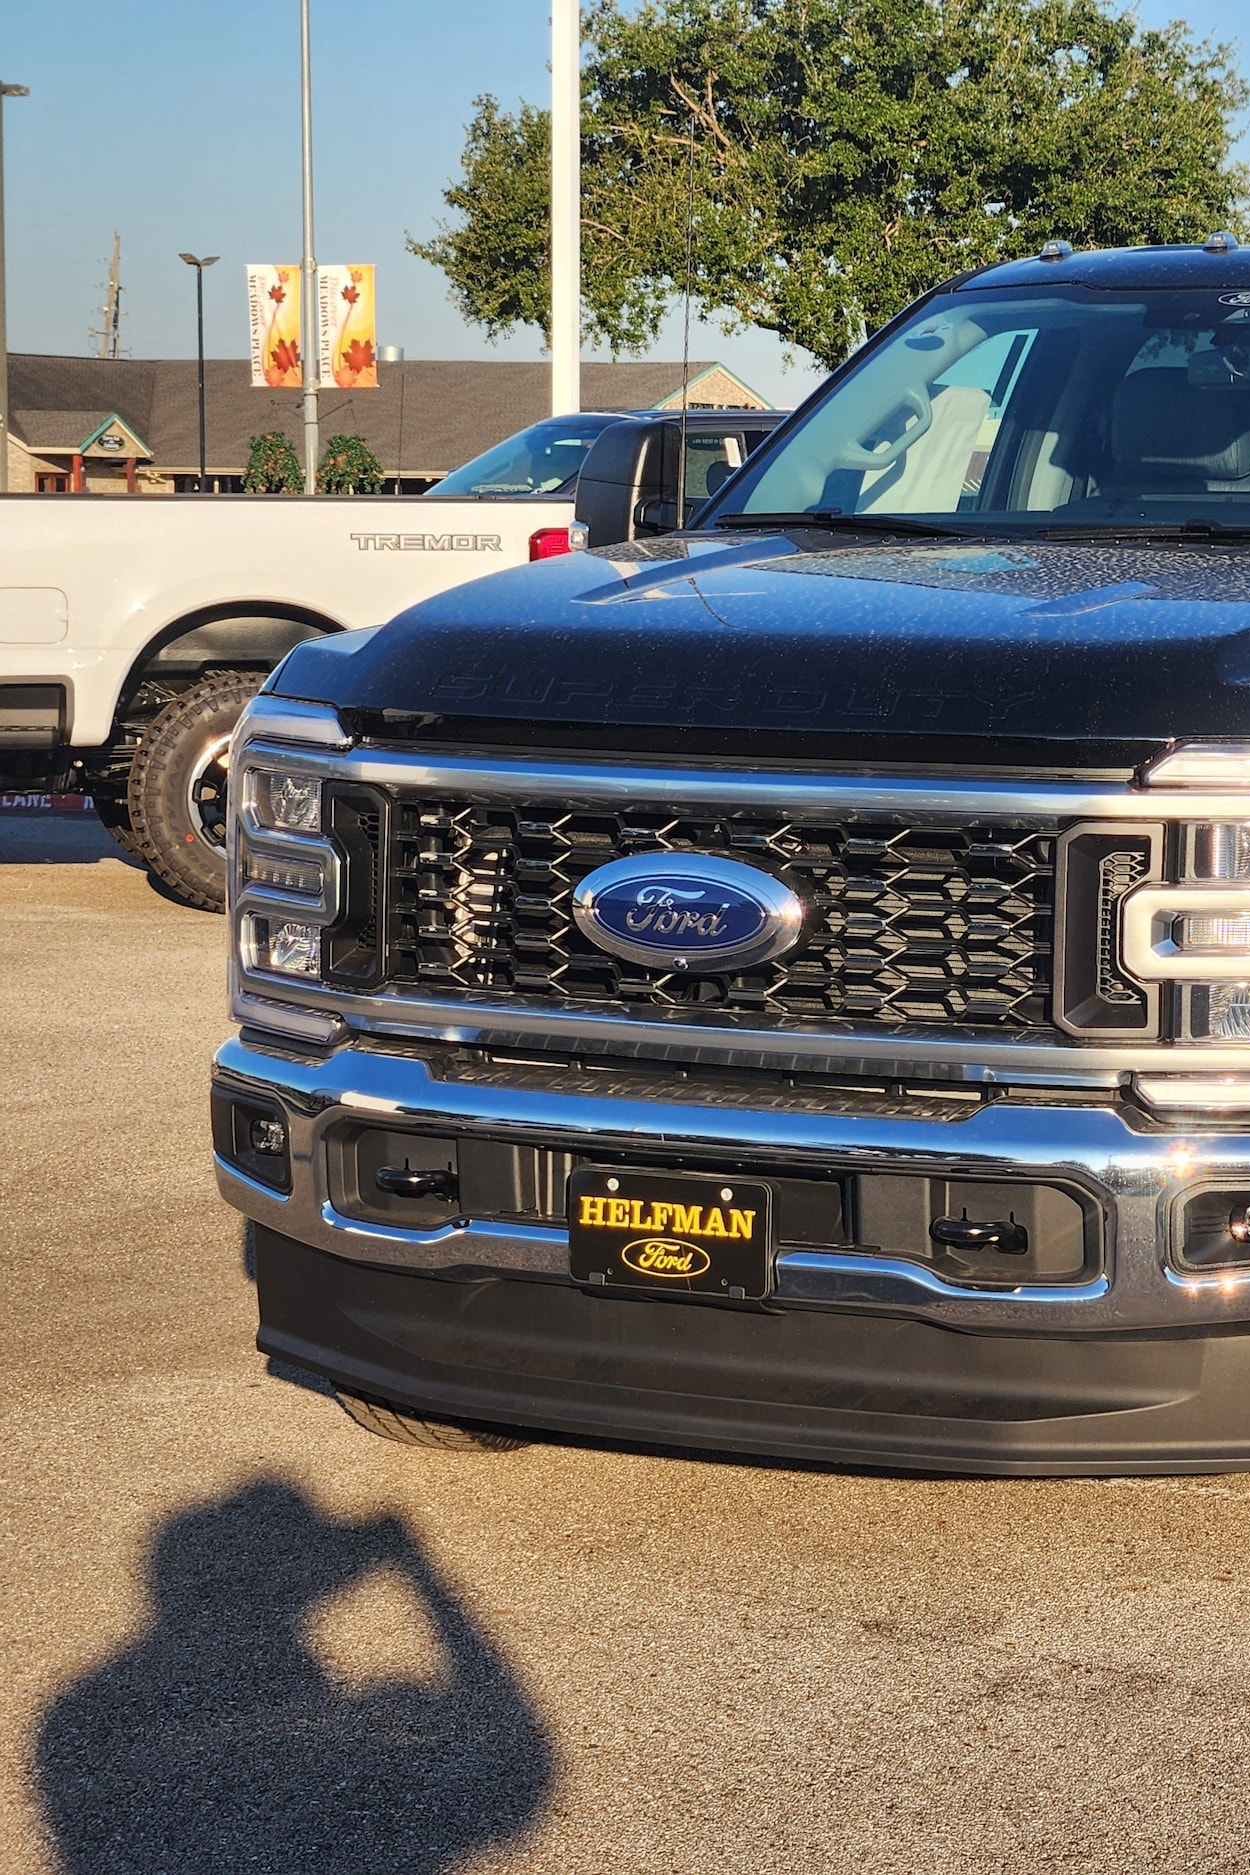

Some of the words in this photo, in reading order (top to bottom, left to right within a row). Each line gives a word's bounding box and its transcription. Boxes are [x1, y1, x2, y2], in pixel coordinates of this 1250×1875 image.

[249, 274, 259, 335] MEADOWS
[319, 275, 330, 337] MEADOWS
[251, 338, 261, 376] PLACE
[320, 339, 332, 378] PLACE
[350, 533, 503, 551] TREMOR
[432, 673, 741, 712] SUPER
[756, 685, 1038, 721] DUTY
[2, 793, 52, 808] LANE
[626, 885, 731, 937] Ford
[579, 1195, 757, 1240] HELFMAN
[638, 1241, 694, 1272] Ford
